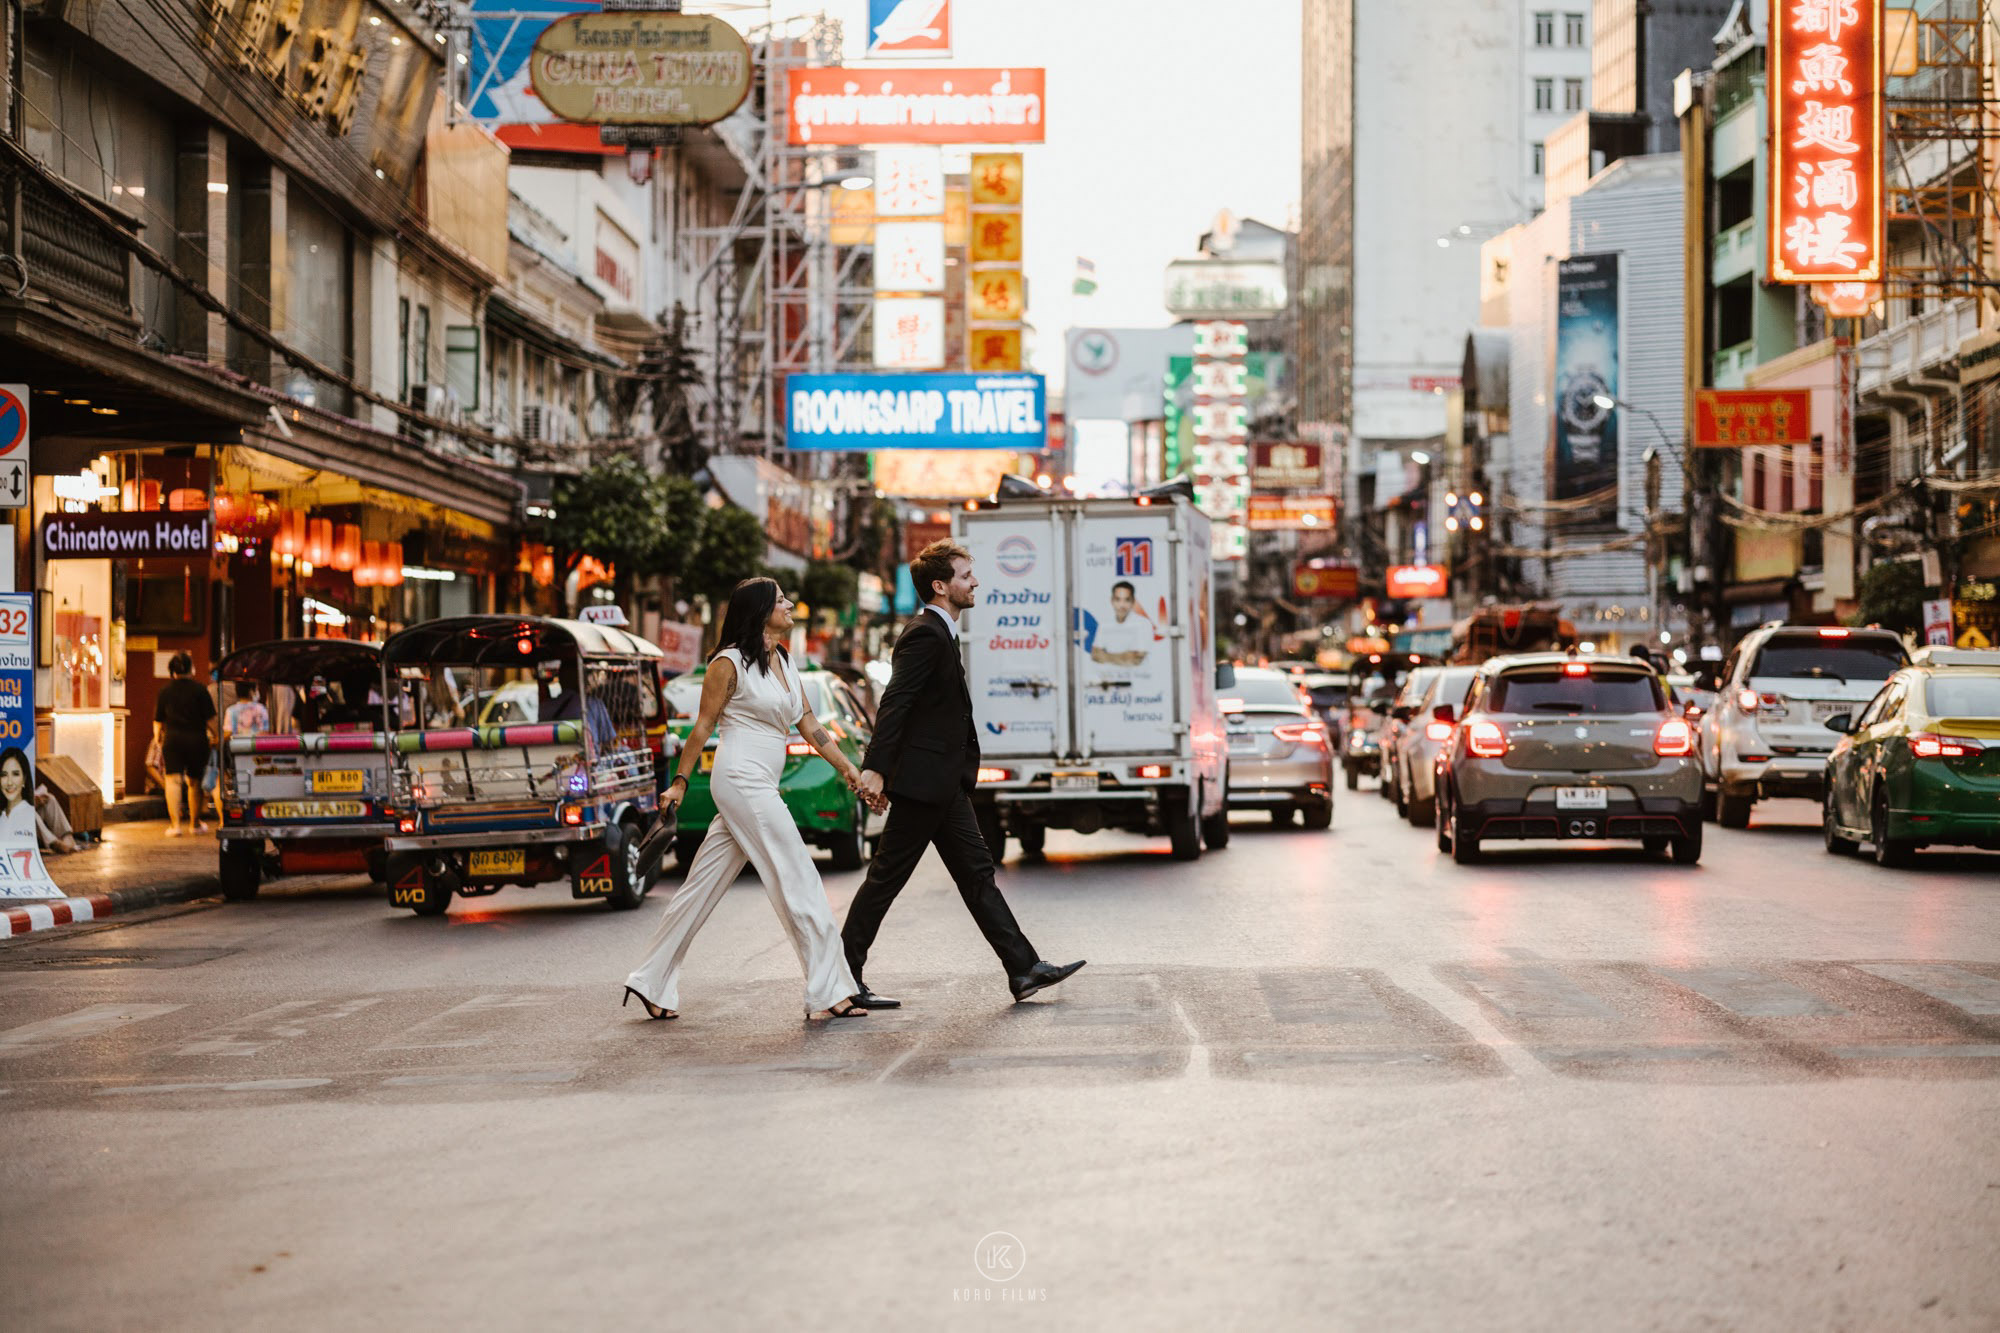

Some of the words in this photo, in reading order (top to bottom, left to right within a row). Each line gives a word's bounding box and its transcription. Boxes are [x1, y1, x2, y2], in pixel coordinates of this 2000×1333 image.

[541, 50, 645, 86] CHINA
[650, 52, 743, 87] TOWN
[592, 87, 690, 114] HOTEL
[792, 389, 944, 435] ROONGSARP
[947, 390, 1042, 434] TRAVEL
[45, 520, 150, 551] Chinatown
[156, 518, 208, 549] Hotel
[1117, 541, 1151, 575] 11
[986, 588, 1052, 605] ก้าวข้าม
[997, 615, 1041, 627] ความ
[989, 633, 1050, 651] ขัดแย้ง
[264, 801, 361, 818] THAILAND
[12, 850, 32, 880] 7
